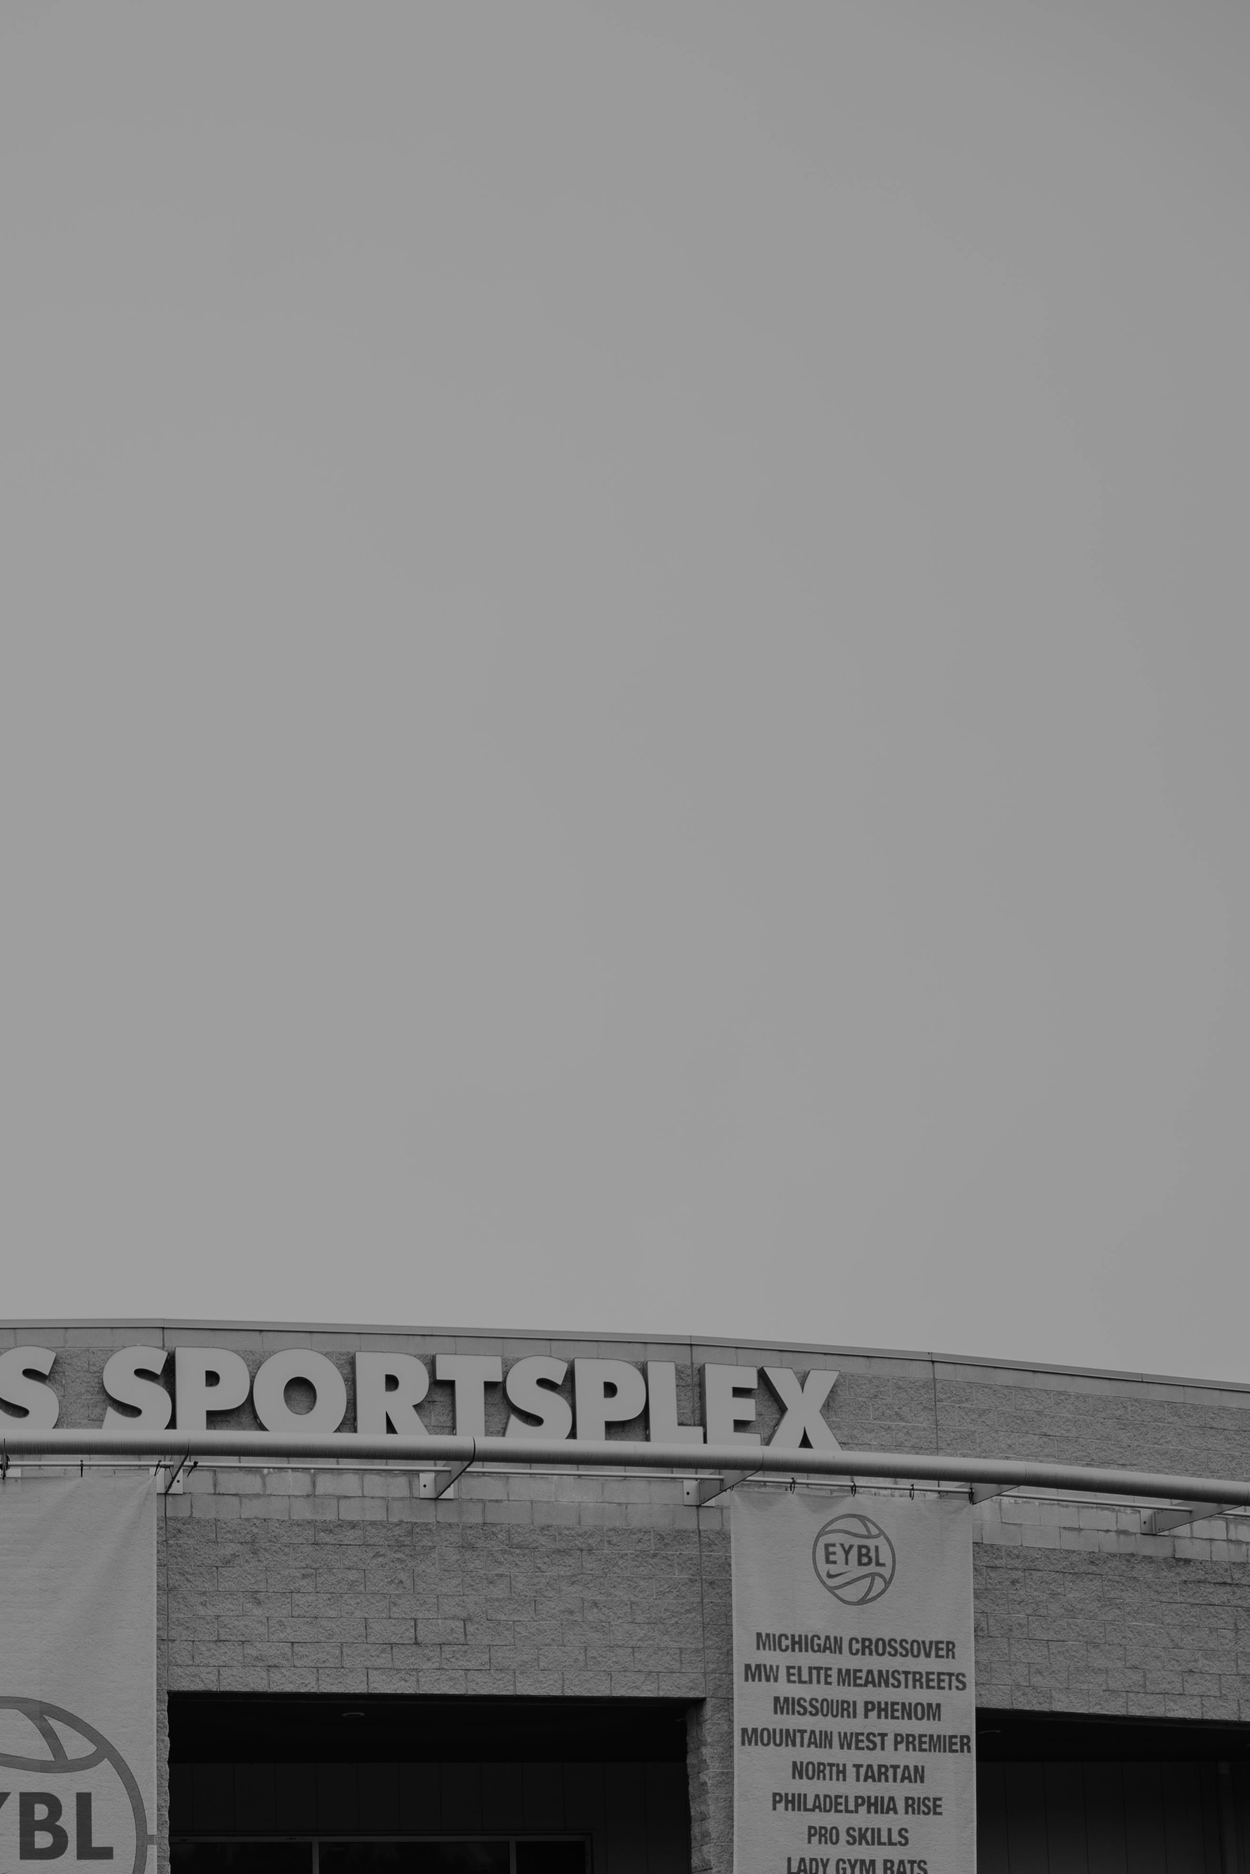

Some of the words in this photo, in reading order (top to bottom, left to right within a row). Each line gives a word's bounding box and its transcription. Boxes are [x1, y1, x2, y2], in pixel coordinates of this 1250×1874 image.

[102, 1345, 842, 1450] SPORTSPLEX
[824, 1543, 886, 1567] EYBL
[756, 1632, 842, 1654] MICHIGAN
[849, 1637, 955, 1659] CROSSOVER
[745, 1664, 779, 1682] MW
[786, 1666, 832, 1685] ELITE
[837, 1668, 966, 1691] MEANSTREETS
[774, 1696, 857, 1718] MISSOURI
[864, 1701, 941, 1721] PHENOM
[741, 1728, 832, 1749] MOUNTAIN
[838, 1732, 888, 1751] WEST
[894, 1733, 971, 1753] PREMIER
[792, 1761, 846, 1781] NORTH
[853, 1764, 924, 1783] TARTAN
[772, 1793, 898, 1814] PHILADELPHIA
[905, 1797, 942, 1815] RISE
[808, 1826, 839, 1845] PRO
[846, 1827, 909, 1846] SKILLS
